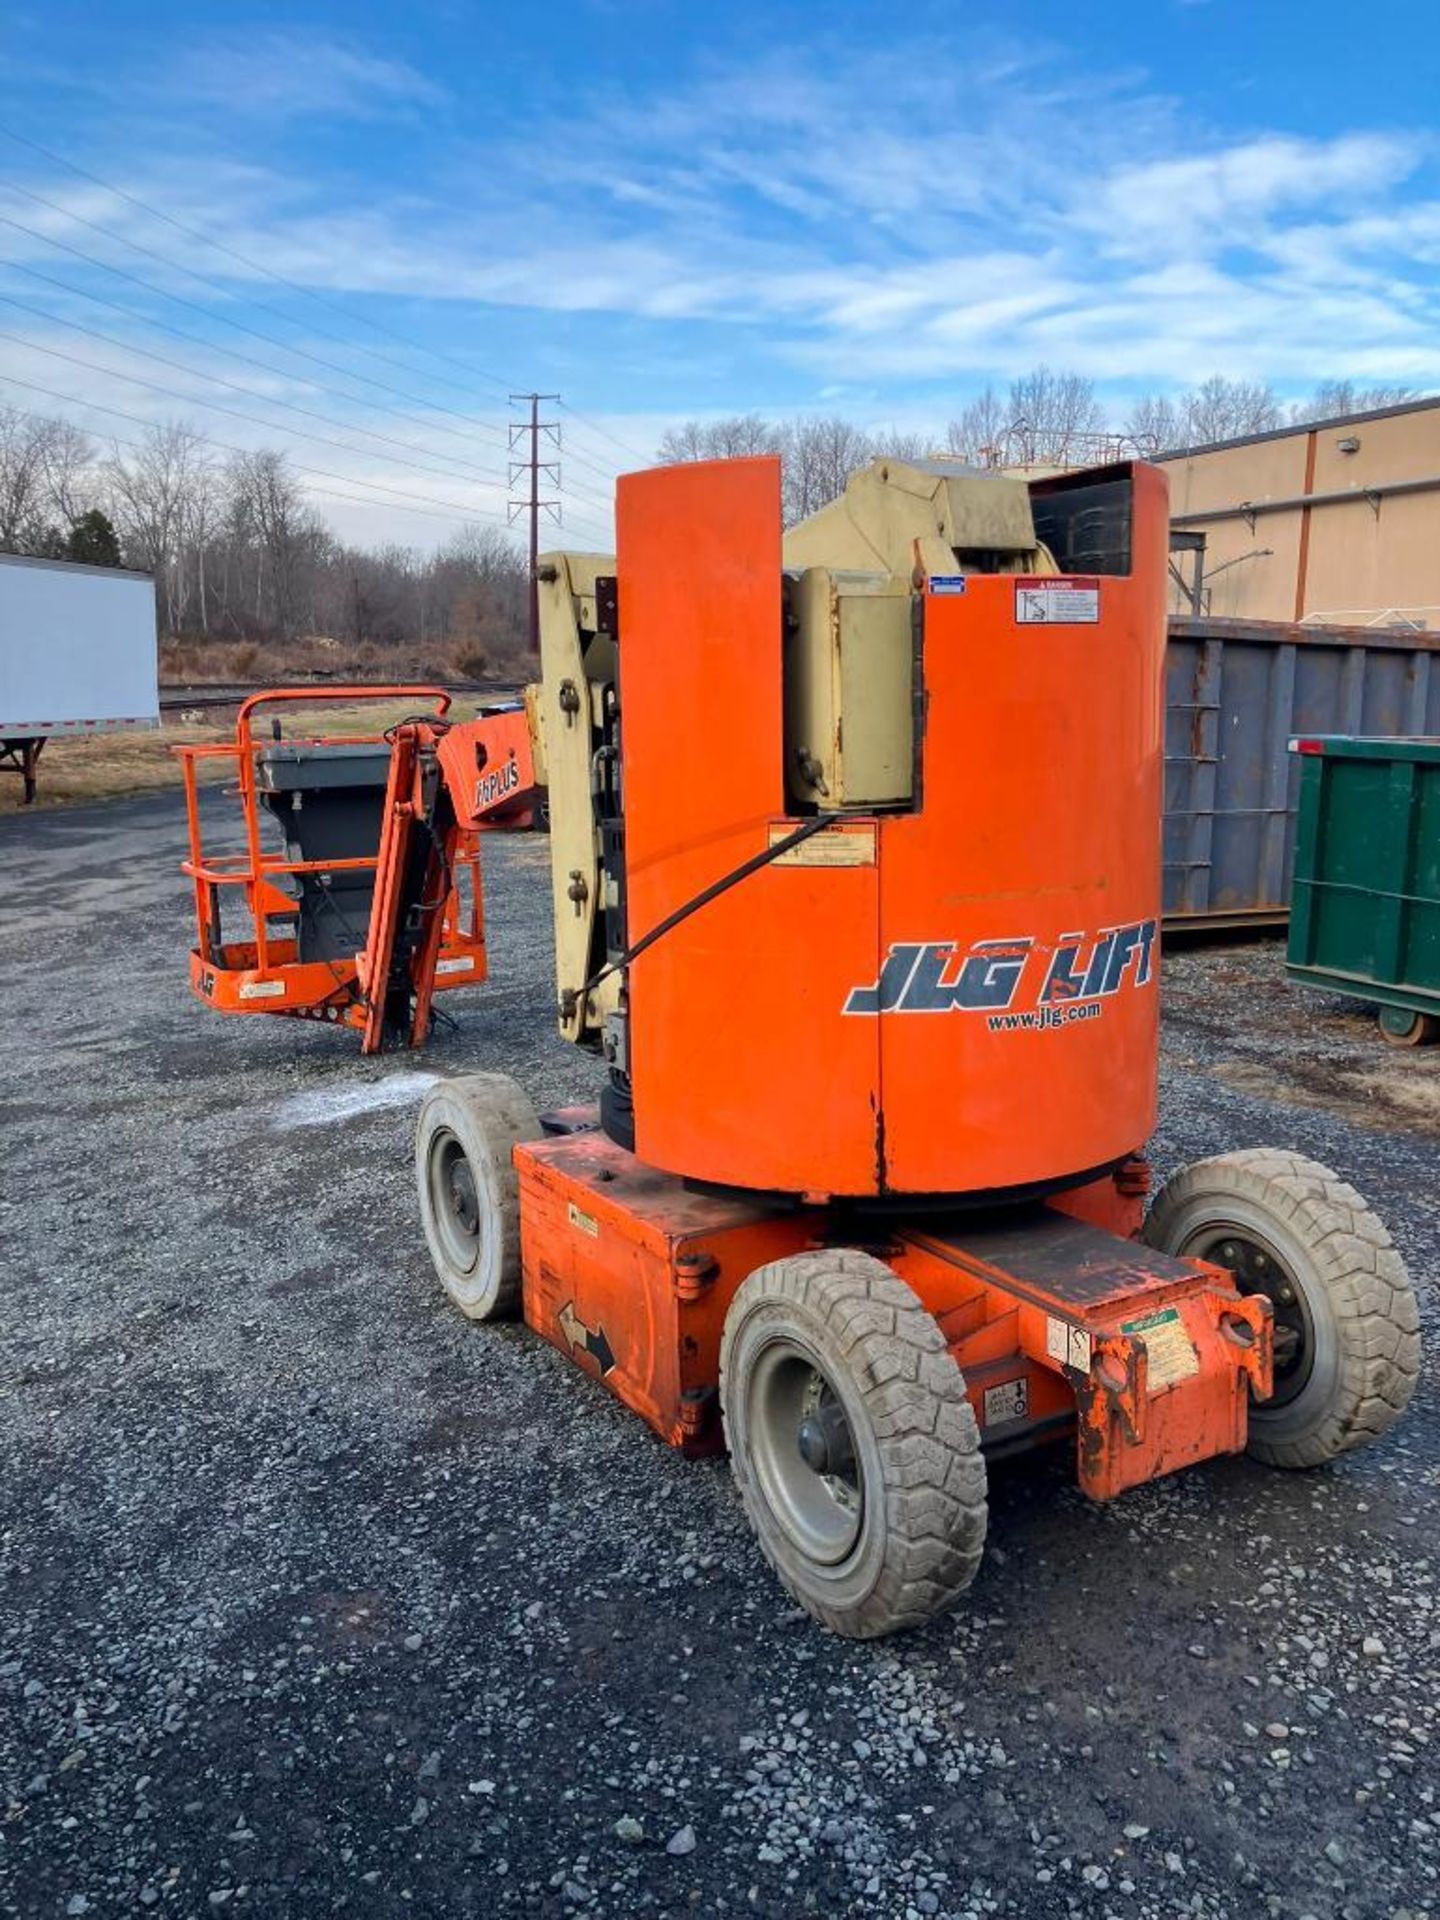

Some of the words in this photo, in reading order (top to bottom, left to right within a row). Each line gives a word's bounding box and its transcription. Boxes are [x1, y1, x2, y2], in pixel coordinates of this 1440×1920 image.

[842, 936, 1035, 1016] JLG
[1036, 918, 1157, 1006] LIFT
[988, 1002, 1102, 1031] www.jlg.com
